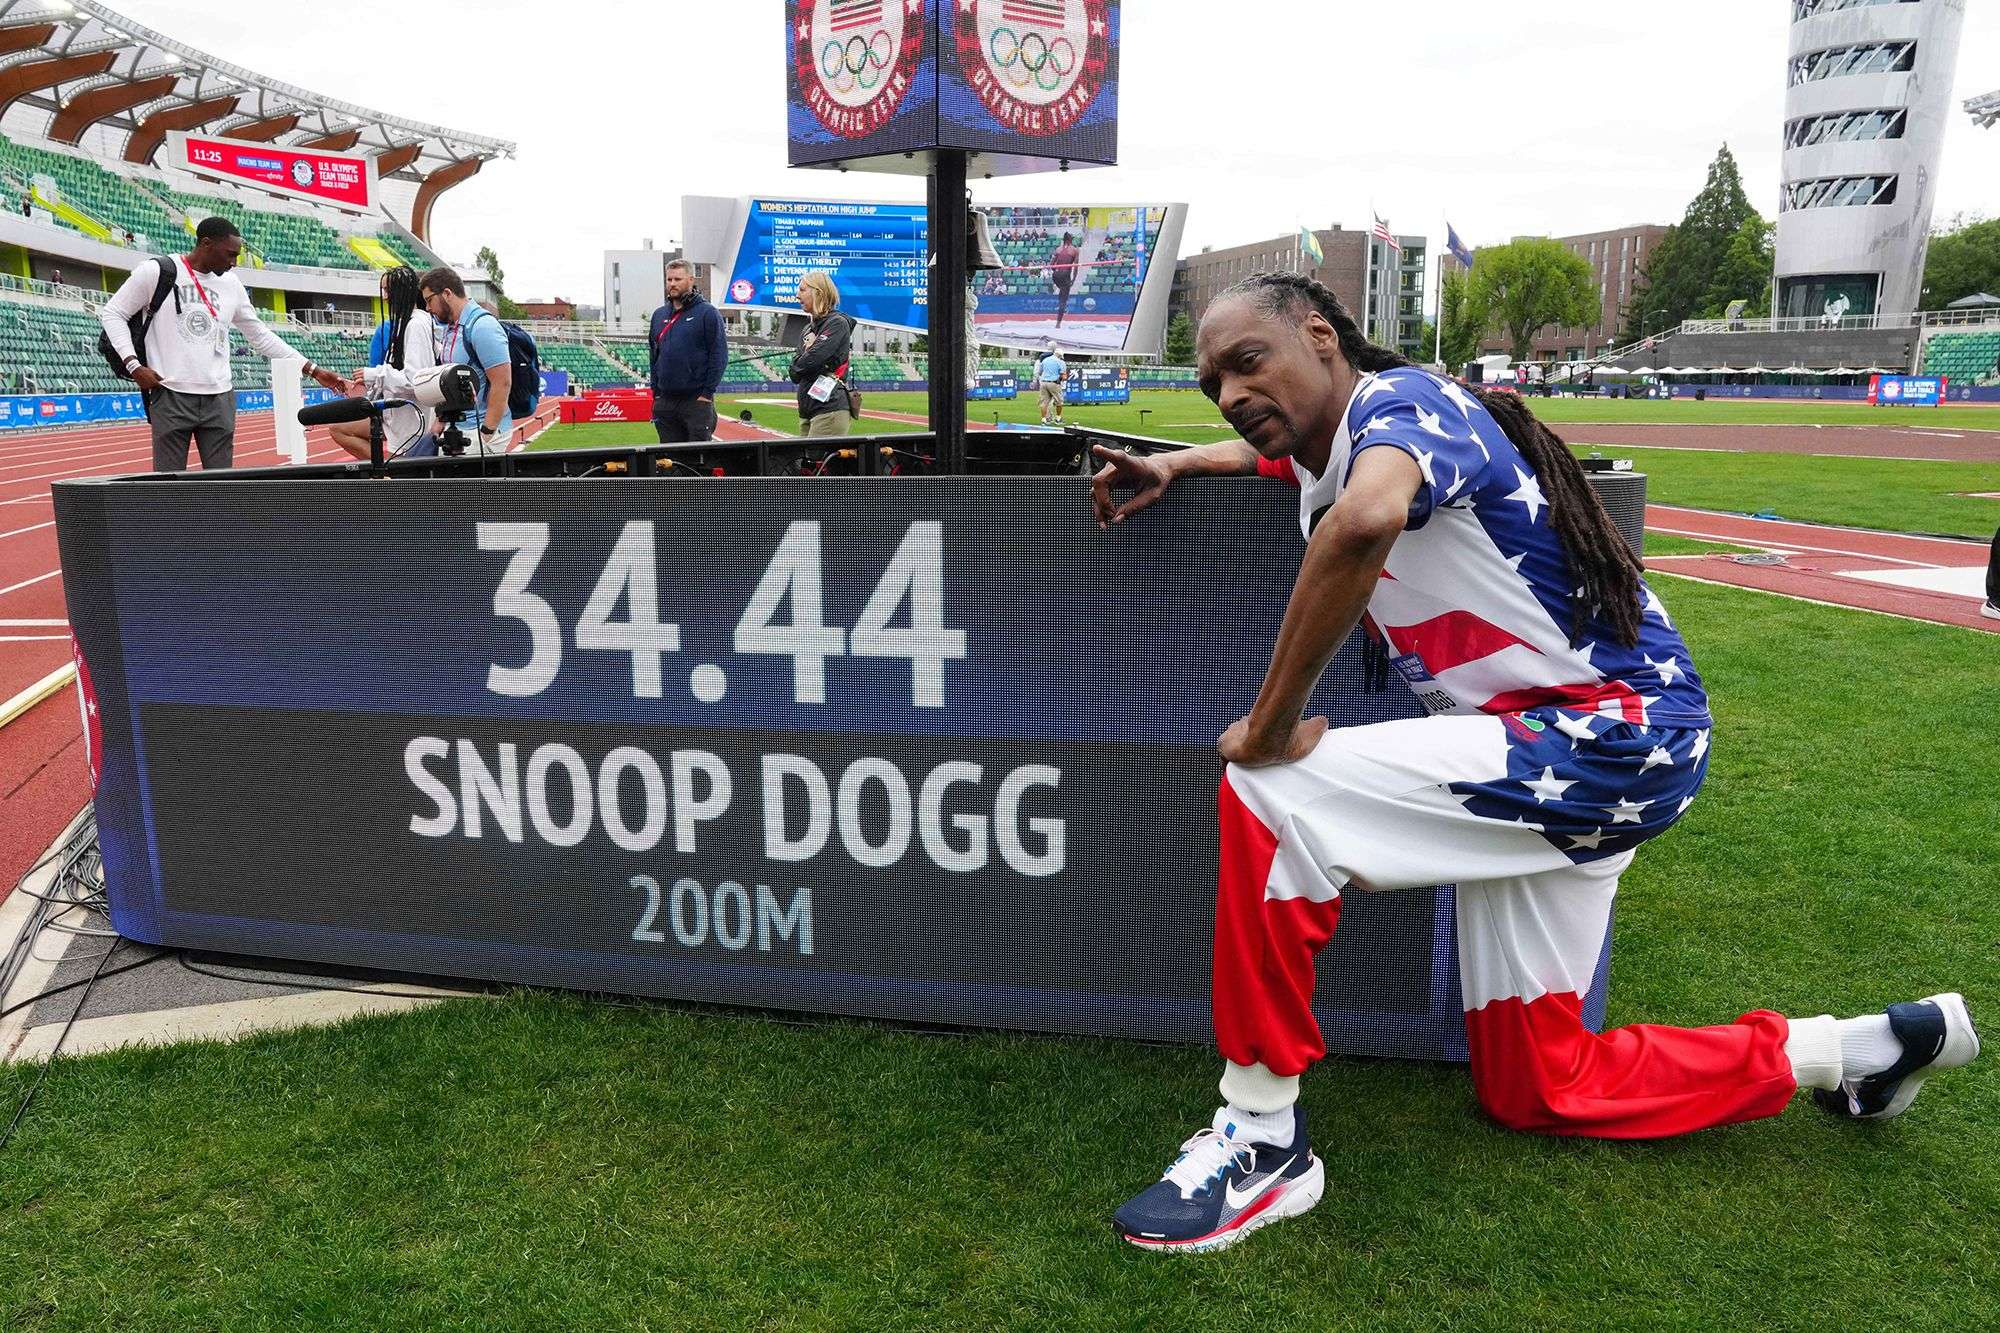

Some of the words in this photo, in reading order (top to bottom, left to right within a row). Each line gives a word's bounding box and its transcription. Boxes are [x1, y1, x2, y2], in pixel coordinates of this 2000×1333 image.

[974, 68, 1042, 129] OLYMPIC
[810, 85, 864, 131] OLYMPIC
[194, 149, 222, 162] 11:25
[257, 159, 271, 169] TEAM
[318, 161, 331, 171] U.S.
[331, 163, 359, 174] OLYMPIC
[319, 171, 337, 181] TEAM
[337, 172, 359, 183] TRIALS
[760, 202, 794, 212] WOMEN'S
[794, 204, 840, 214] HEPTATHLON
[840, 206, 858, 215] HIGH
[858, 207, 878, 215] JUMP
[775, 217, 796, 226] TIMARA
[796, 218, 824, 227] CHAPMAN
[773, 256, 807, 265] MICHELLE
[807, 257, 842, 266] ATHERLEY
[901, 259, 916, 268] 1.64
[773, 266, 808, 275] CHEYENNE
[901, 268, 916, 277] 1.64
[773, 275, 793, 284] JADIN
[901, 278, 916, 287] 1.58
[773, 284, 793, 294] ANNA
[594, 401, 623, 417] Lilly
[475, 519, 967, 708] 34.44
[403, 736, 732, 854] SNOOP
[762, 754, 1067, 877] DOGG
[629, 875, 815, 955] 200M
